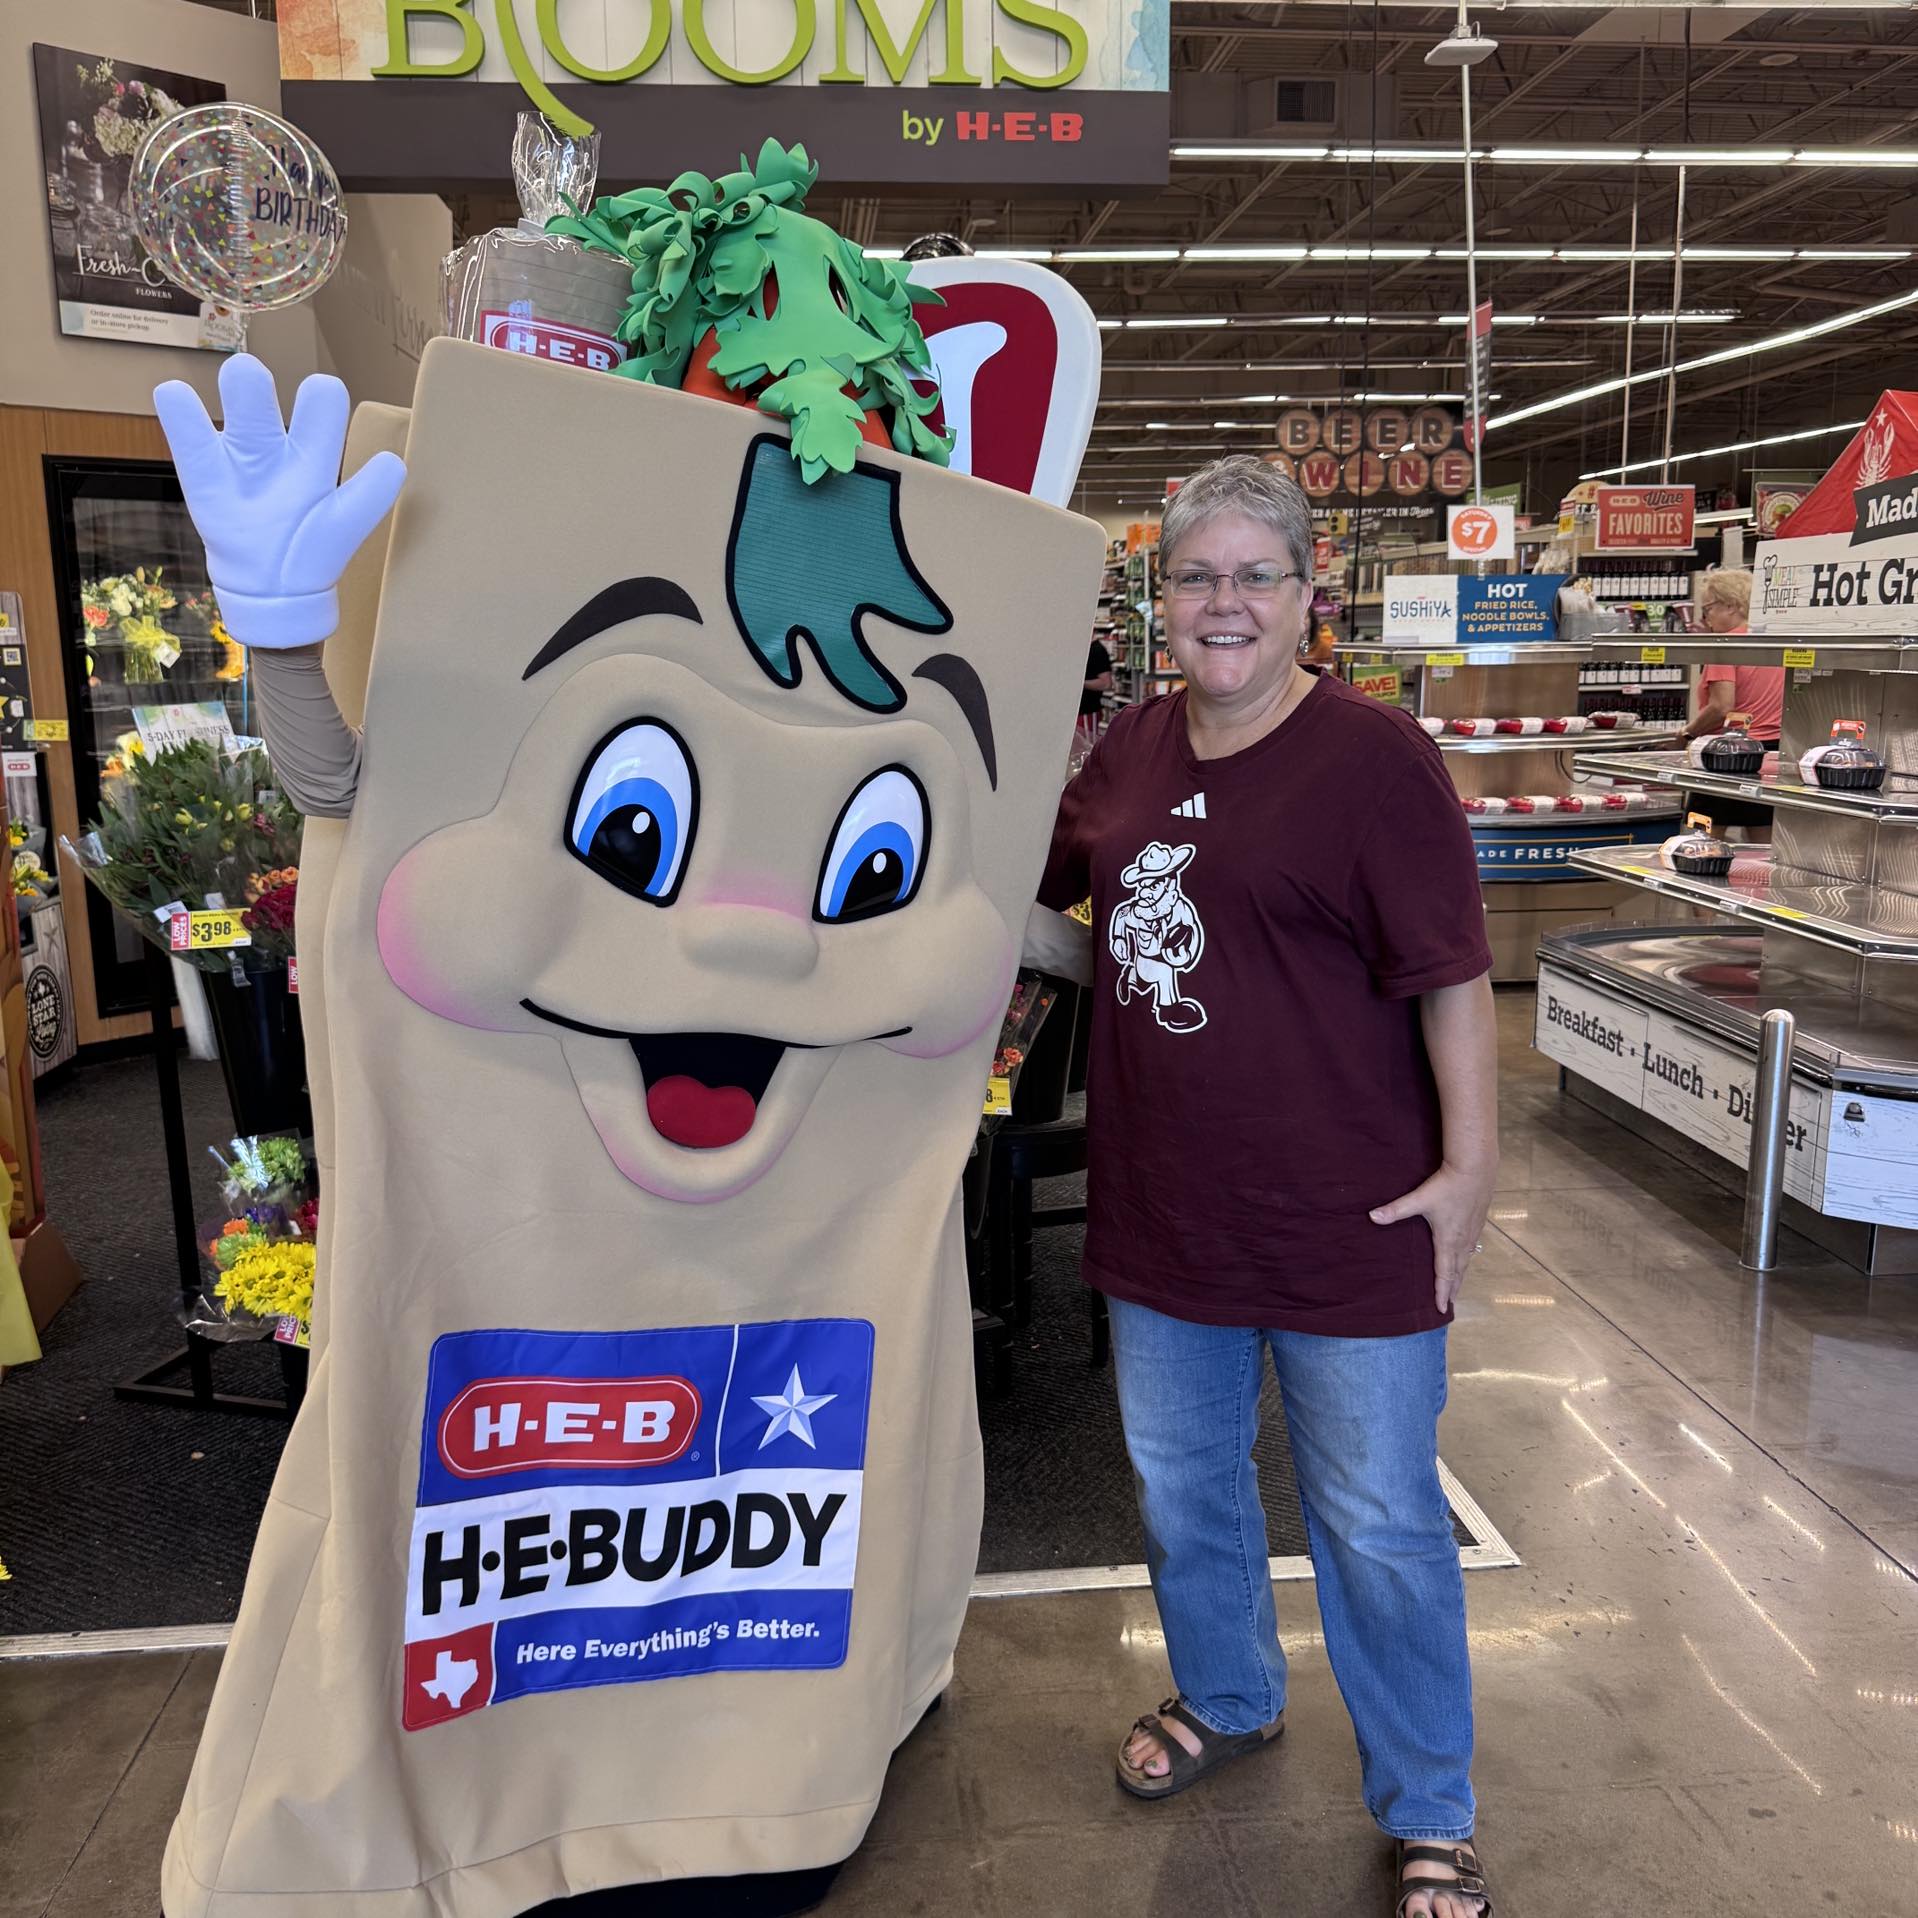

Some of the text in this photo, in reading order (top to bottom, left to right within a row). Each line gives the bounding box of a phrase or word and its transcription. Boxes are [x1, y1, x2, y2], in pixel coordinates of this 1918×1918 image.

[903, 111, 1084, 146] by H-E-B
[77, 244, 168, 287] Fresh-C
[135, 286, 173, 299] FLOWERS
[509, 331, 611, 371] H-E-B
[1287, 417, 1445, 448] BEER
[1303, 459, 1463, 490] WINE
[1644, 490, 1684, 506] Wine
[1461, 520, 1491, 544] $7
[1609, 512, 1684, 535] FAVORITES
[1487, 583, 1528, 598] HOT
[1809, 561, 1871, 607] Hot
[1474, 600, 1538, 610] FRIED RICE,
[1647, 604, 1666, 617] 30
[1462, 612, 1507, 621] NOODLE
[1467, 622, 1544, 632] & APPETIZERS
[147, 729, 175, 742] 5-DAY
[1475, 850, 1508, 859] ADE
[171, 921, 181, 942] LOW
[31, 994, 56, 1014] LONE
[32, 1006, 57, 1028] STAR
[1547, 994, 1807, 1152] Breakfast Lunch Dier
[473, 1400, 676, 1452] H-E-B
[516, 1642, 577, 1664] Here
[736, 1618, 821, 1640] Better.
